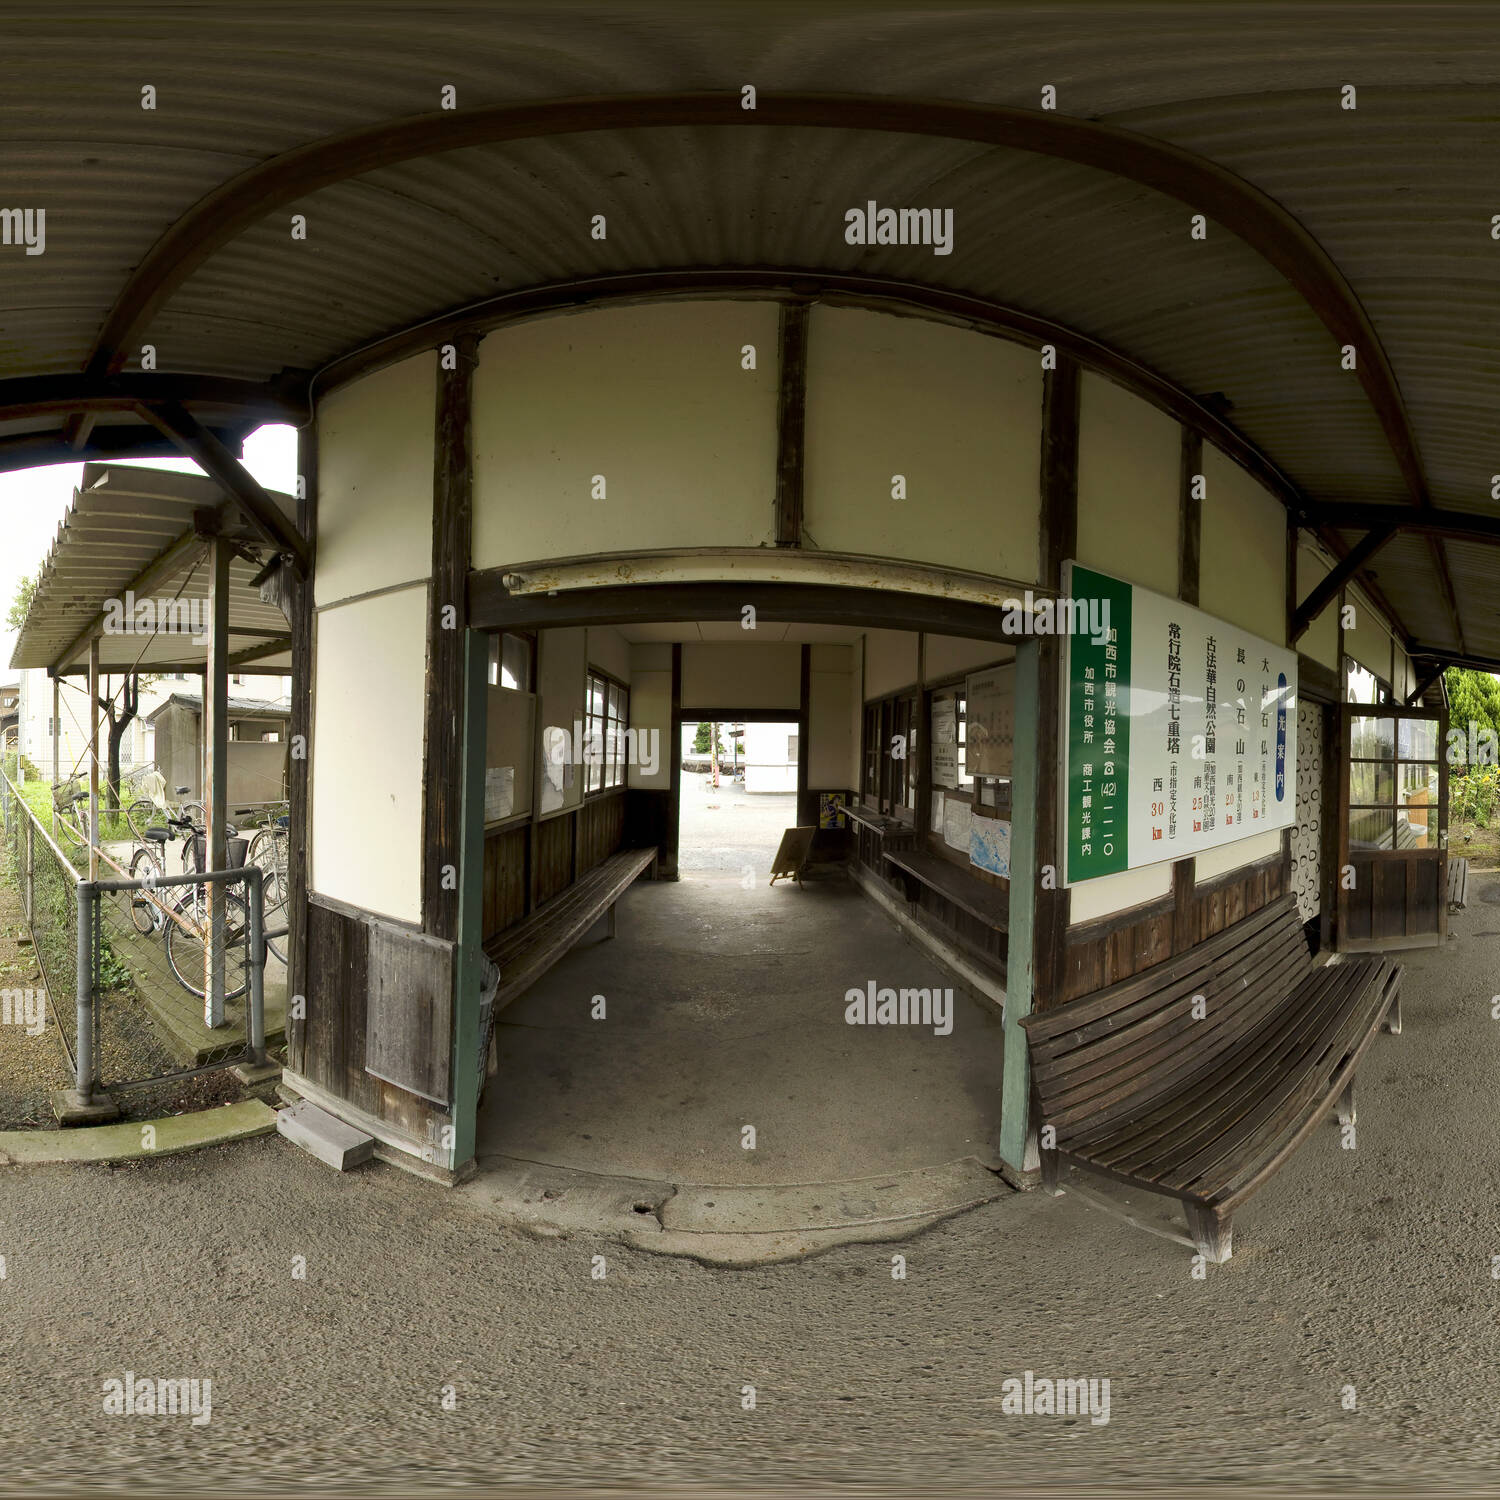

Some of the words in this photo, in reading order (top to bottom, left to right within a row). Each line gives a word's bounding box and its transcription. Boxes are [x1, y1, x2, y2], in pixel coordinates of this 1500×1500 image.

[1083, 666, 1095, 744] 加西市役所
[1167, 622, 1181, 754] 常行院石造七重塔
[1205, 636, 1217, 754] 古法華自然公園
[1236, 647, 1246, 755] 長の石山
[1153, 777, 1163, 792] 西
[1194, 776, 1202, 789] 南
[1276, 714, 1286, 788] 光案内
[1152, 826, 1163, 841] km
[1193, 820, 1202, 833] km
